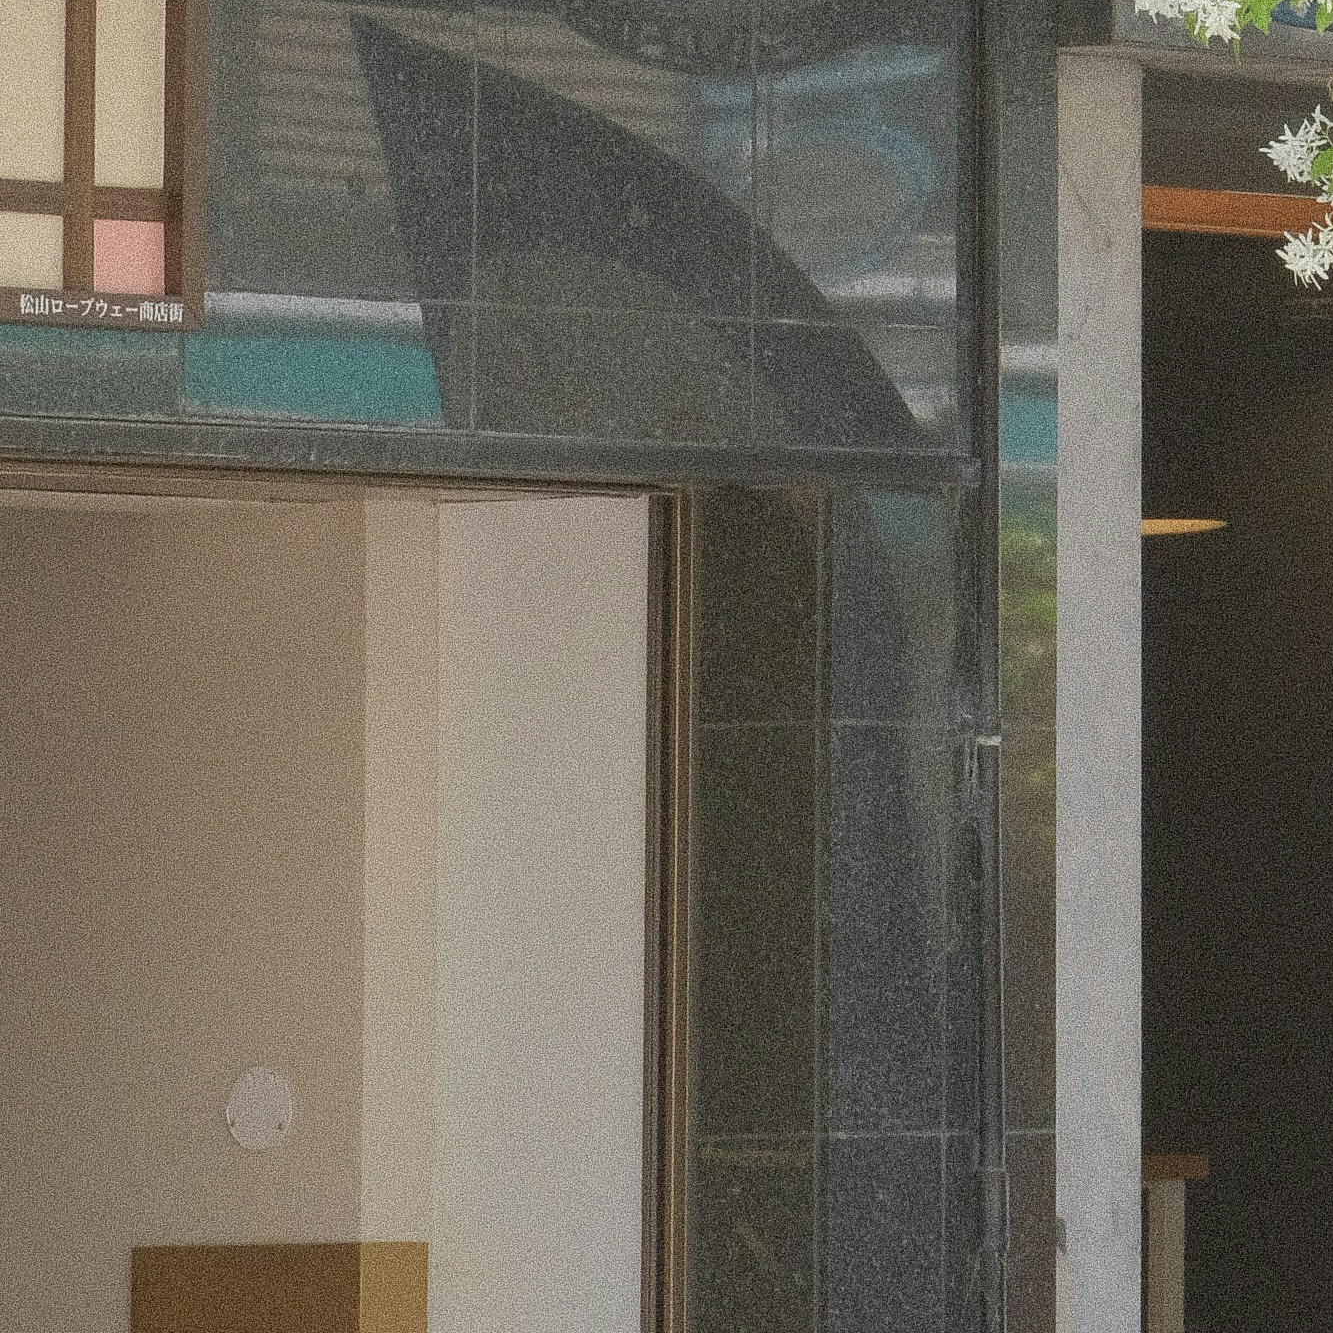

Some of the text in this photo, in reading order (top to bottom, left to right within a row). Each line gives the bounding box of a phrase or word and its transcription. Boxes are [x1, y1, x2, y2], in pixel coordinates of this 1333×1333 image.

[20, 293, 184, 323] 松山ロープウェー商店街
